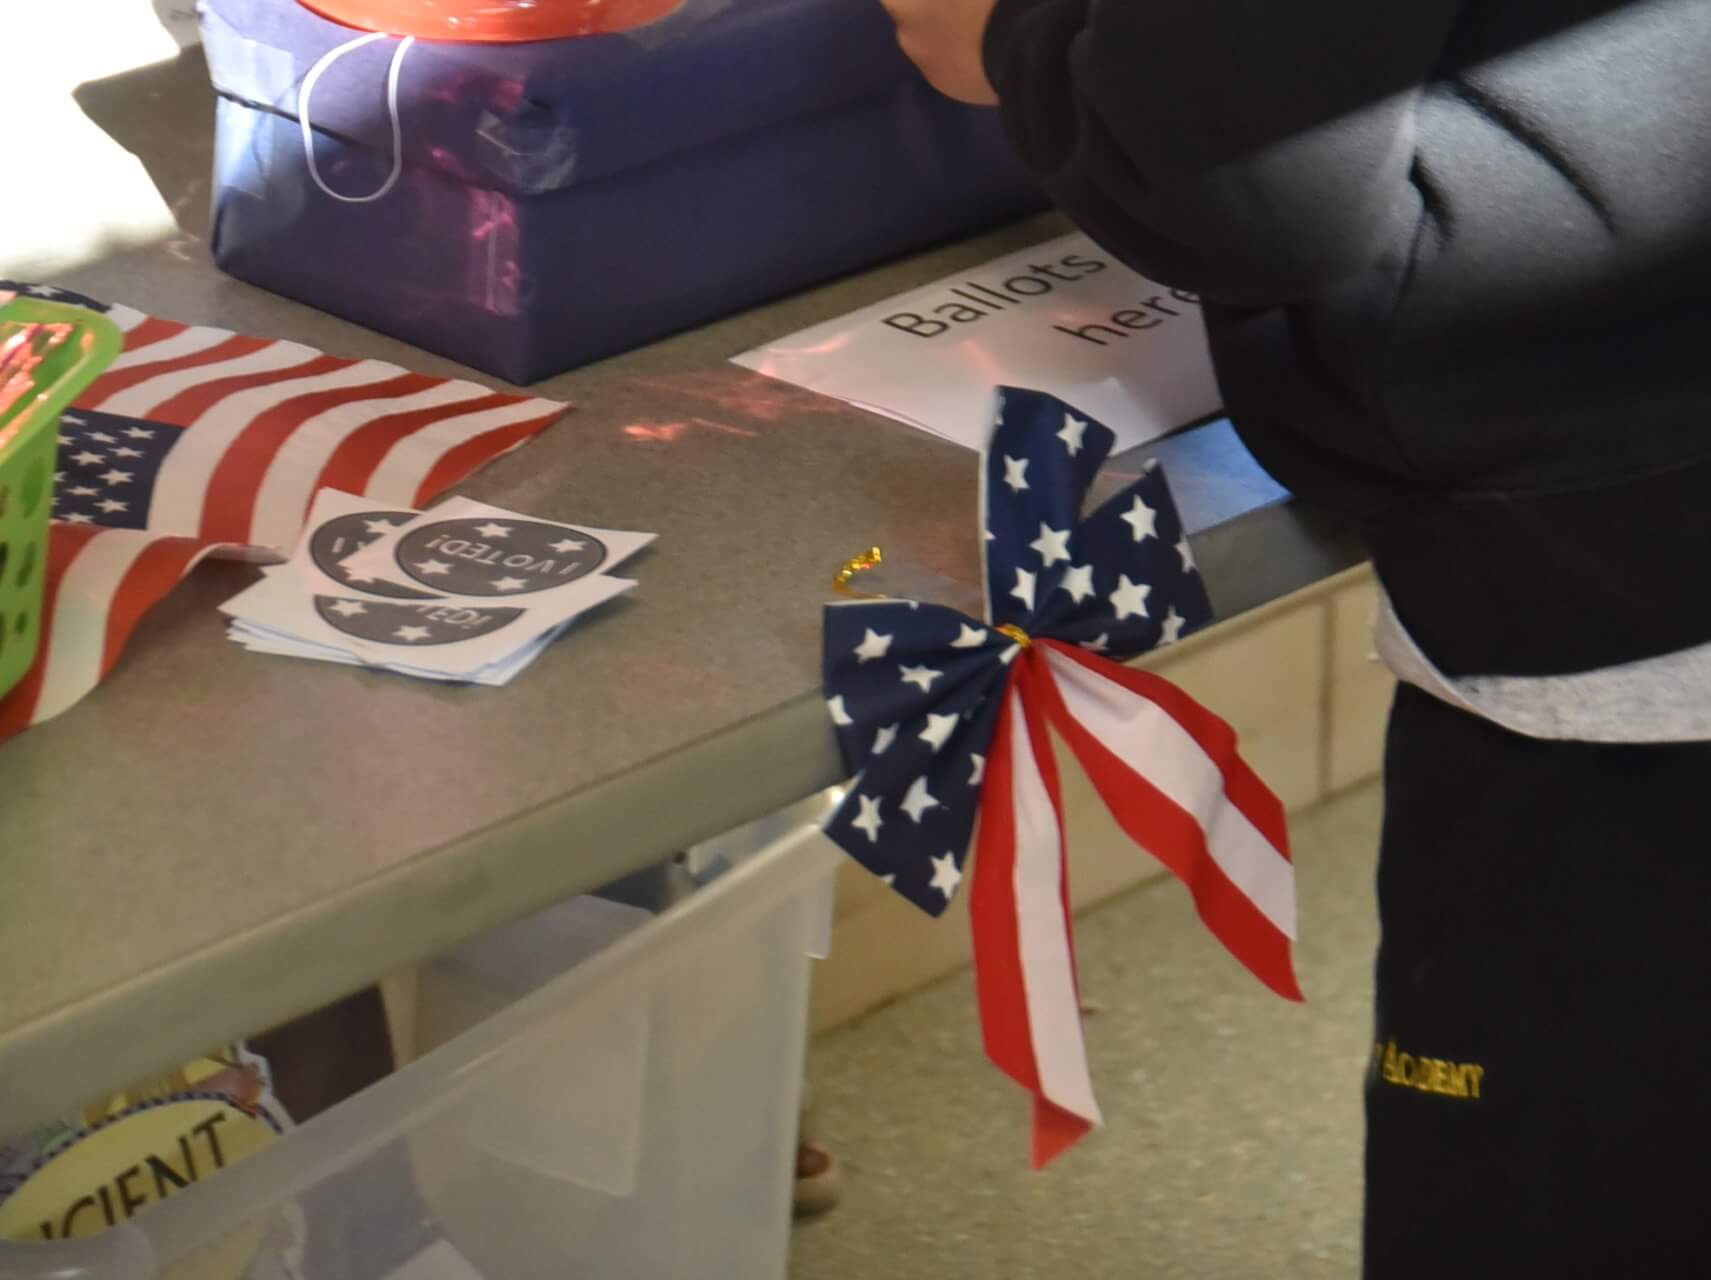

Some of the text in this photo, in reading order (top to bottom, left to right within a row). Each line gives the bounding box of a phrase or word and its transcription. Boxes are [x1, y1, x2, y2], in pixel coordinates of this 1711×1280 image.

[881, 254, 1107, 338] Ballots
[423, 534, 556, 574] VOTED!
[40, 1111, 226, 1241] CIENT
